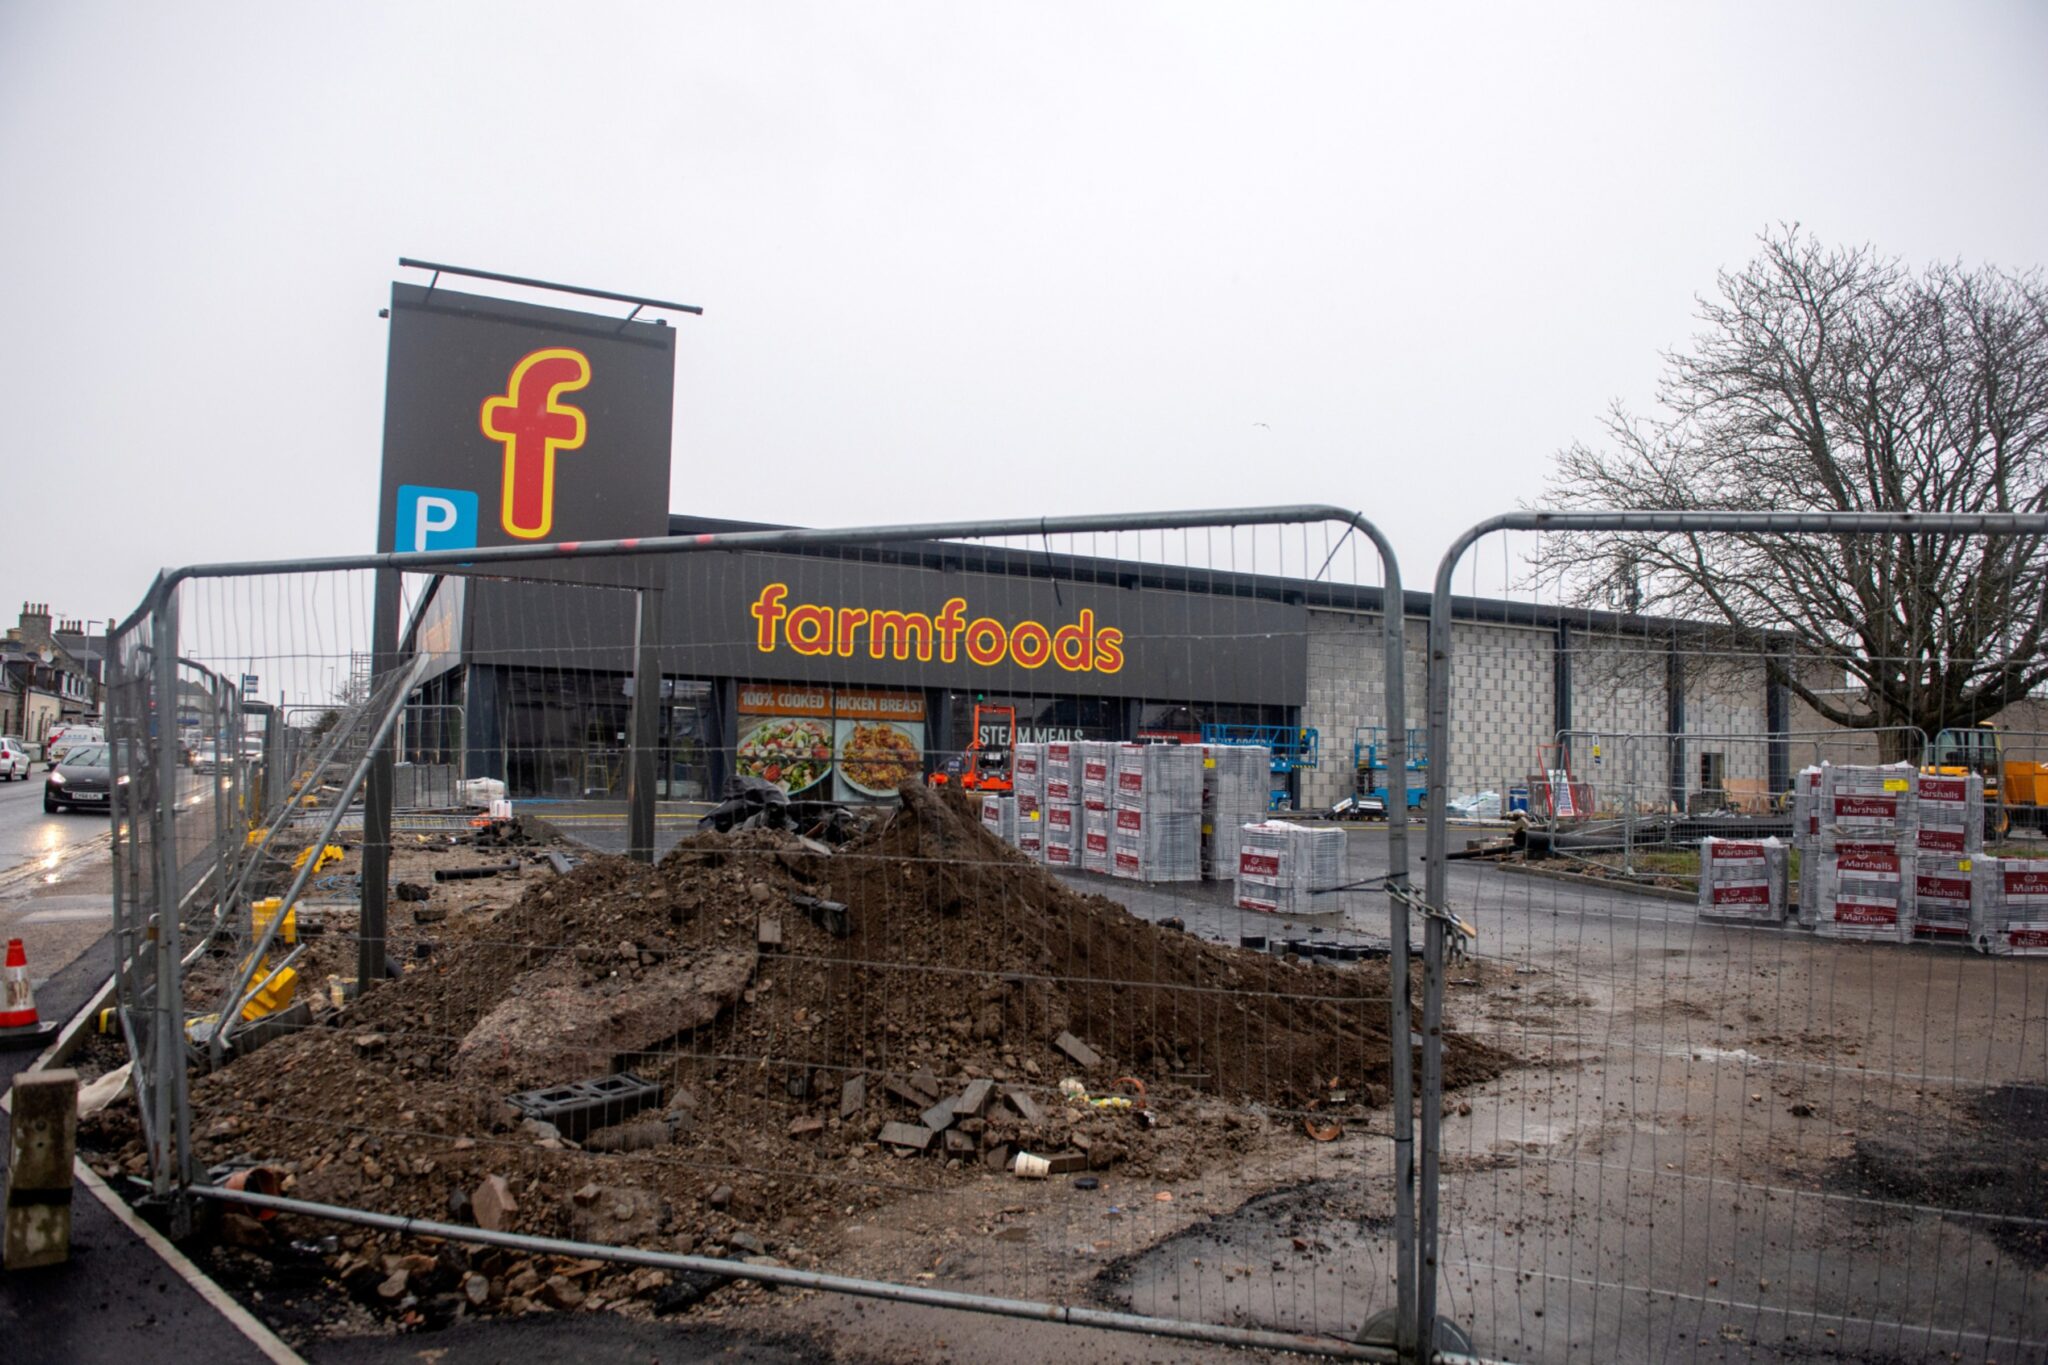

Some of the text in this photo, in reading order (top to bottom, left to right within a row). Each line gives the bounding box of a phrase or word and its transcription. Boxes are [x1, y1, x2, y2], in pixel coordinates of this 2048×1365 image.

[479, 346, 592, 541] f
[414, 495, 458, 553] P
[750, 583, 1125, 674] farmfoods
[742, 691, 775, 707] 100%
[778, 692, 825, 710] COOKED
[879, 698, 924, 713] BREAST
[1842, 805, 1889, 815] Marshalls
[1717, 848, 1758, 857] Marshalls
[1845, 860, 1893, 871] Marshalls
